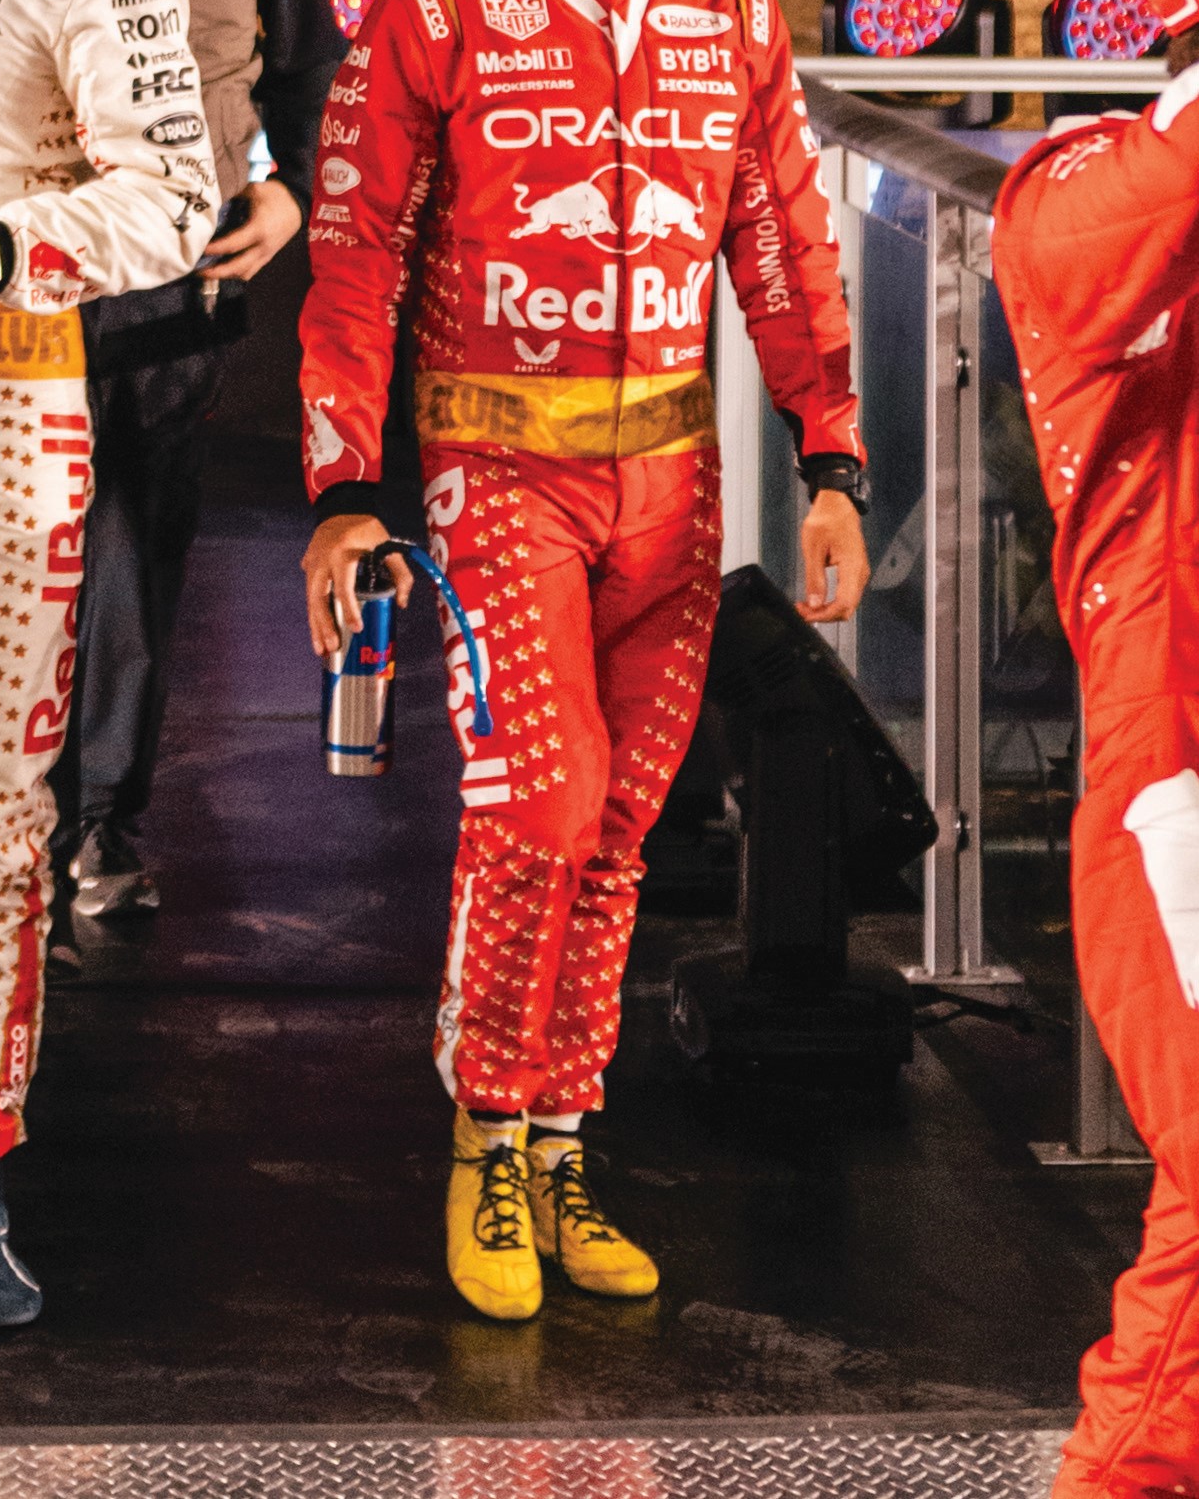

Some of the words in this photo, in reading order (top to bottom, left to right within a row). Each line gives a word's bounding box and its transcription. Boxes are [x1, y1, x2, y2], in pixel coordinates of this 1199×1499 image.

[488, 12, 546, 36] HEUER
[669, 14, 721, 29] RAUCH
[476, 49, 546, 75] Mobil
[659, 43, 732, 73] BYBIT
[131, 67, 195, 103] HRC
[493, 79, 576, 94] POKERSTARS
[657, 78, 738, 96] HONDA
[333, 119, 361, 147] Sui
[482, 106, 738, 151] ORACLE
[753, 205, 782, 252] YOU
[484, 260, 618, 332] Red
[630, 260, 713, 333] Bull
[41, 413, 93, 574] Bull
[23, 586, 80, 755] Red
[445, 637, 512, 808] Bull
